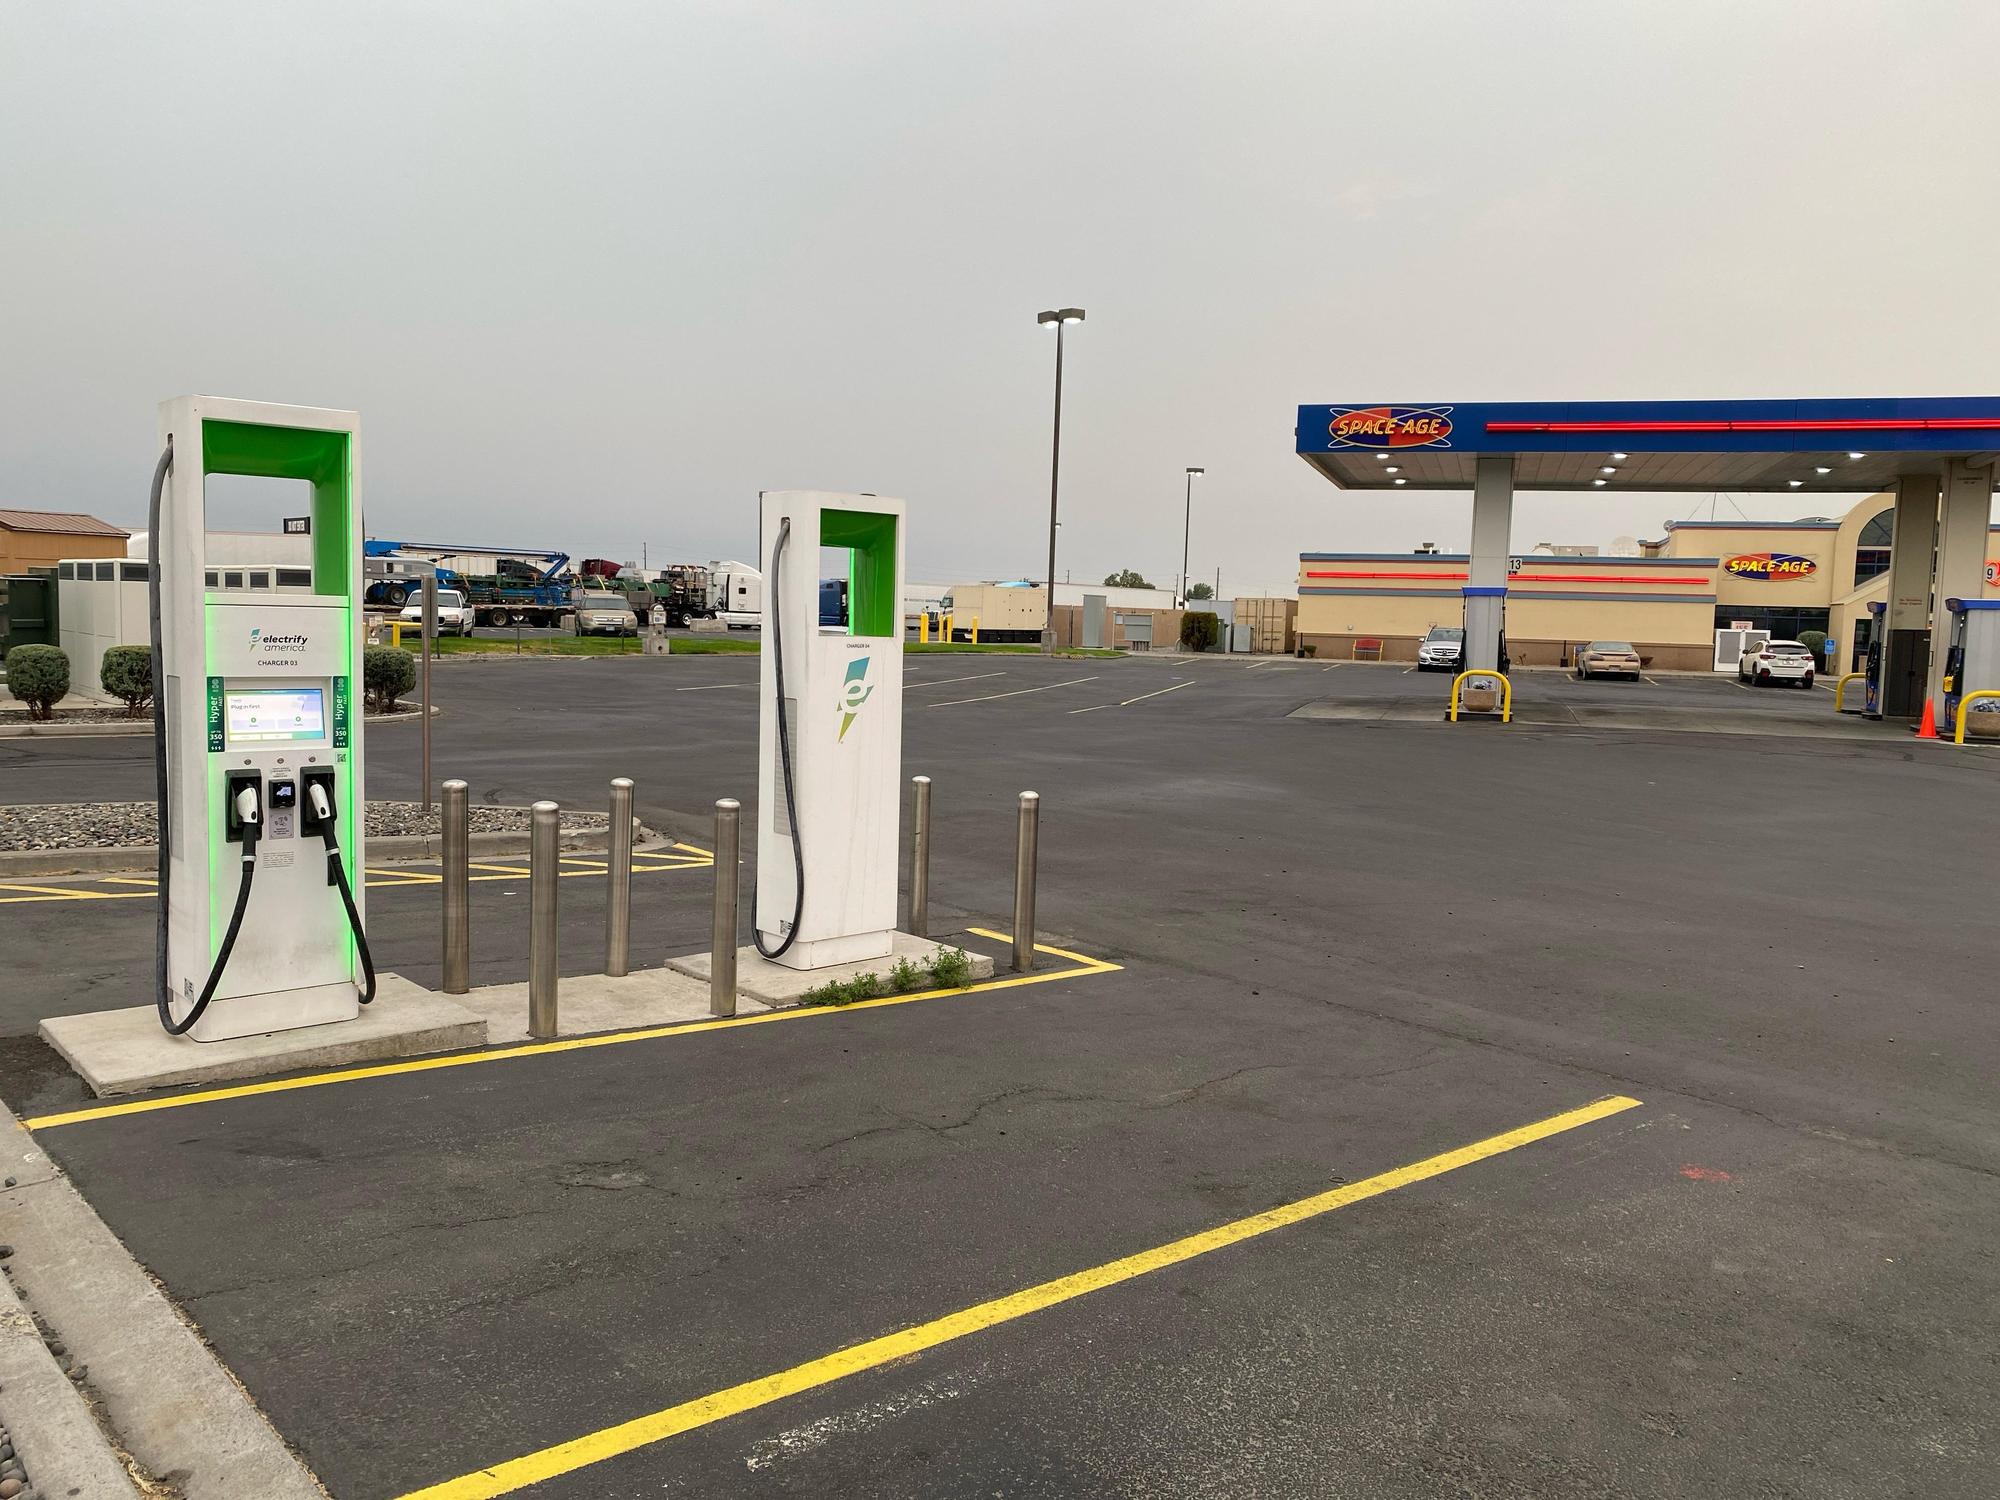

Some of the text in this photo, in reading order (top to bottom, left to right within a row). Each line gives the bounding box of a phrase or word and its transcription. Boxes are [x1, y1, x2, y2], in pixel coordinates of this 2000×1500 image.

[1337, 418, 1442, 435] SPACE AGE
[1509, 559, 1521, 570] 13
[1729, 560, 1811, 573] SPACE AGE
[1986, 567, 1994, 580] 9
[262, 634, 309, 645] electrify
[209, 696, 220, 723] Hyper
[335, 694, 345, 720] Hyper
